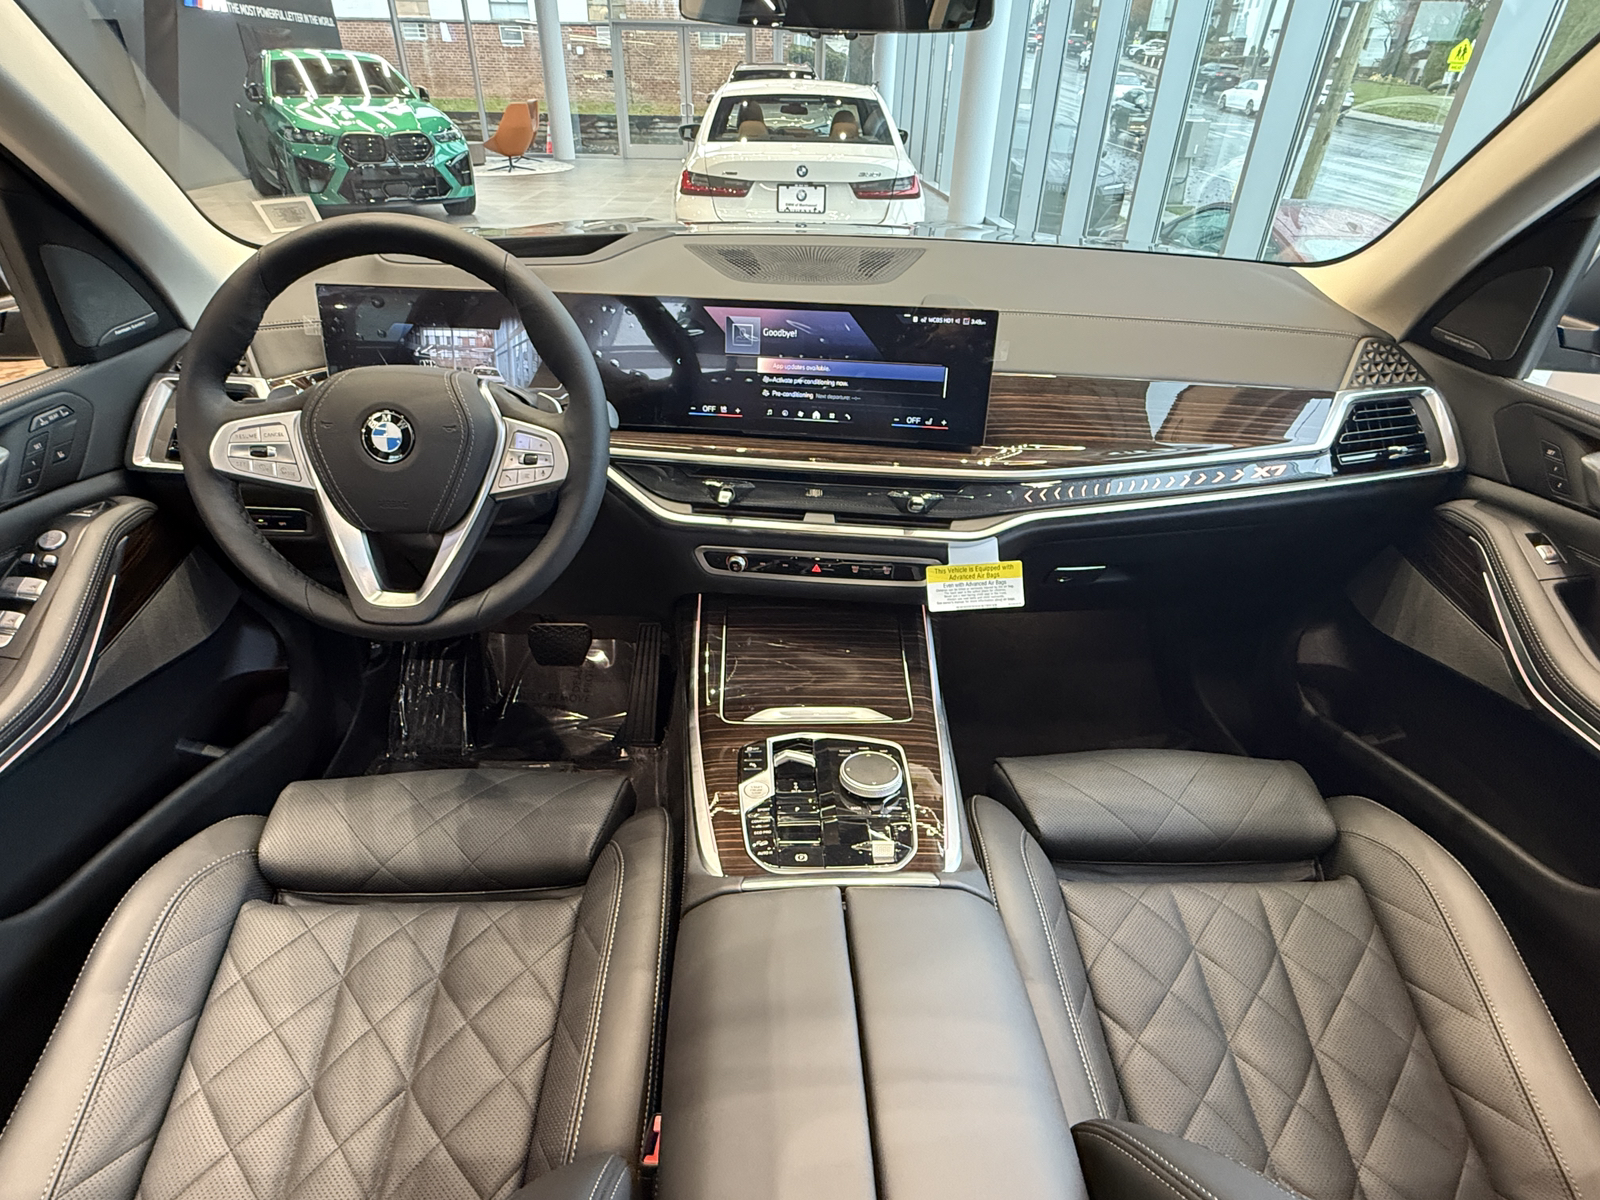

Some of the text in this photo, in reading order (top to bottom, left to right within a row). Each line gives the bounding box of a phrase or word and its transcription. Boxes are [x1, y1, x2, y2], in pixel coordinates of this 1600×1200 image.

[226, 1, 240, 14] THE
[240, 4, 256, 17] MOST
[256, 6, 285, 20] POWERFUL
[285, 11, 304, 23] LETTER
[762, 327, 798, 339] Goodbye!
[772, 362, 784, 370] App
[784, 363, 805, 371] updates
[771, 390, 814, 400] Pre-conditioning
[367, 413, 409, 430] BMW
[906, 416, 921, 424] OFF
[1250, 464, 1287, 479] X7
[948, 566, 968, 574] Vehicle
[975, 565, 1001, 573] Equipped
[986, 571, 1000, 579] Bags
